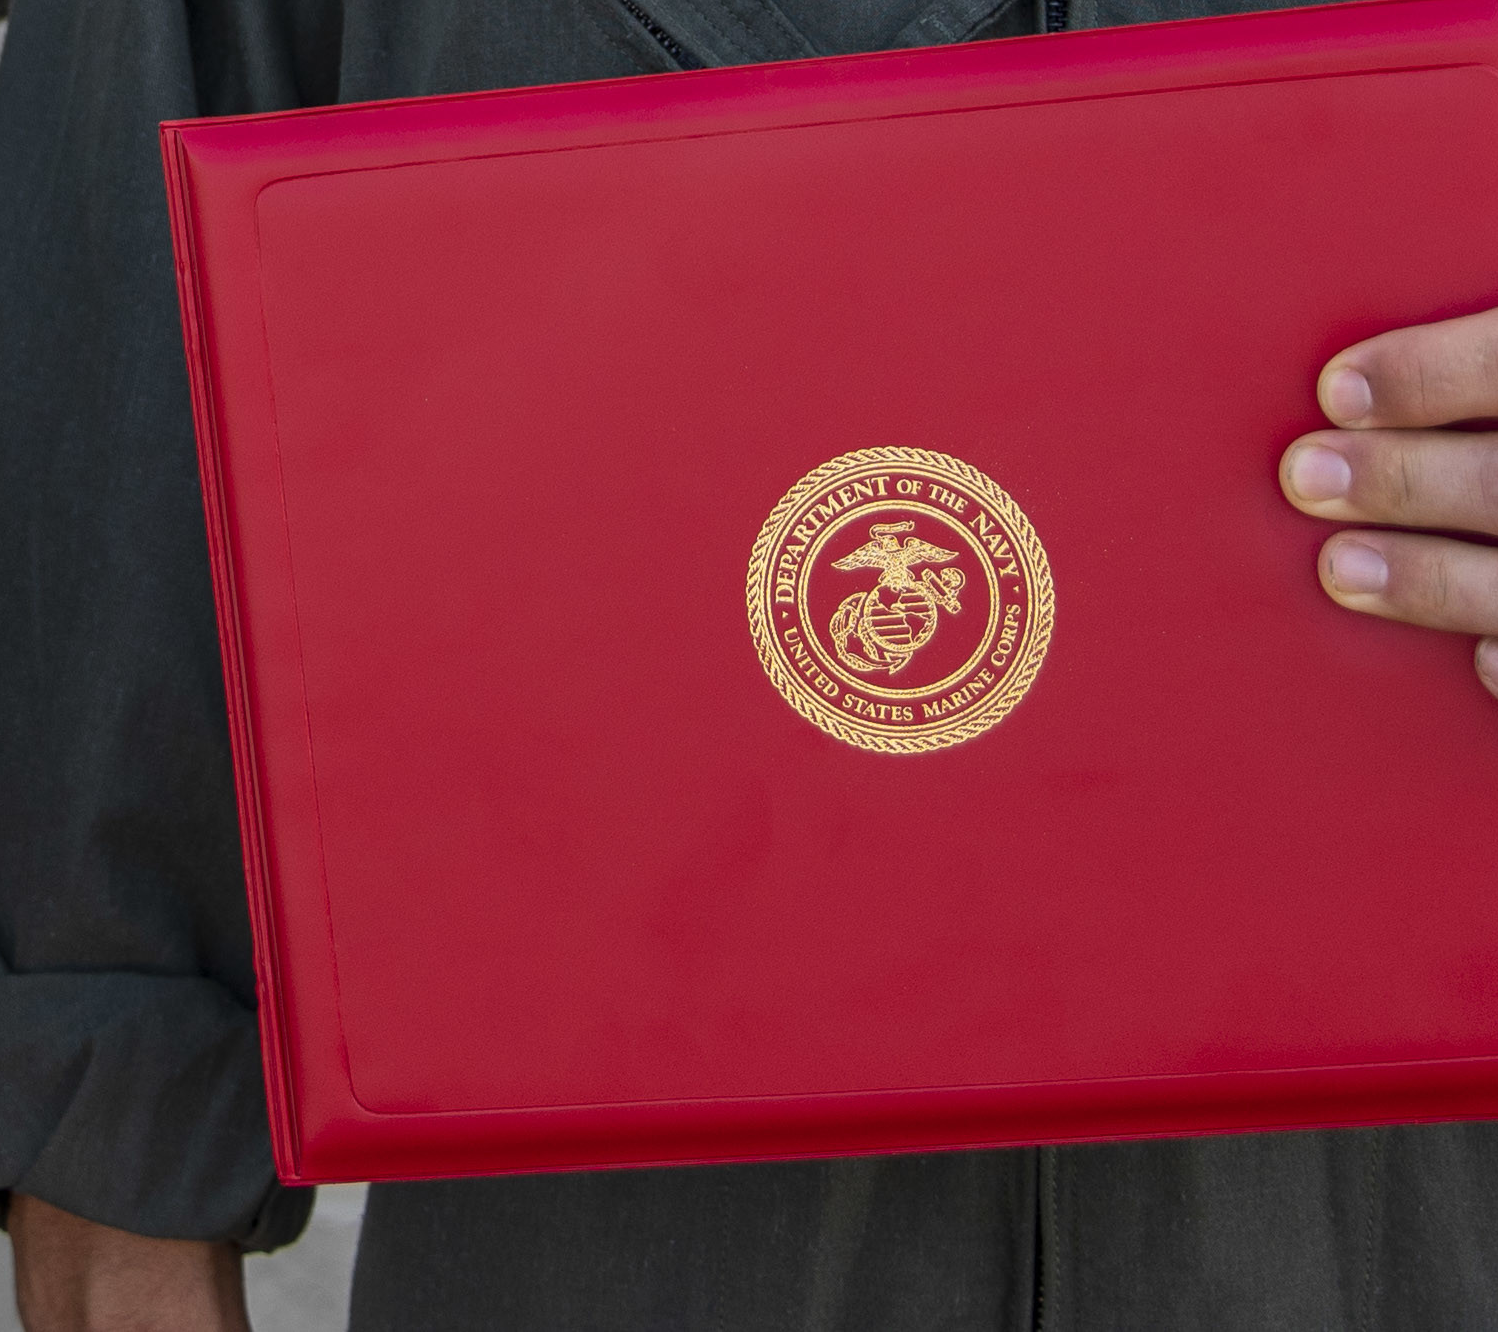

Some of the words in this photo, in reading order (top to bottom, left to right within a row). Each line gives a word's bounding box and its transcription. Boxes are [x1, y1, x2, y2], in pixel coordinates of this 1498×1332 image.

[775, 476, 890, 604] DEPARTMENT
[897, 479, 922, 494] OF
[928, 484, 968, 513] THE
[968, 511, 1020, 578] NAVY
[783, 627, 839, 697] UNITED
[842, 694, 914, 721] STATES
[923, 669, 995, 718] MARINE
[990, 603, 1021, 666] CORPS
